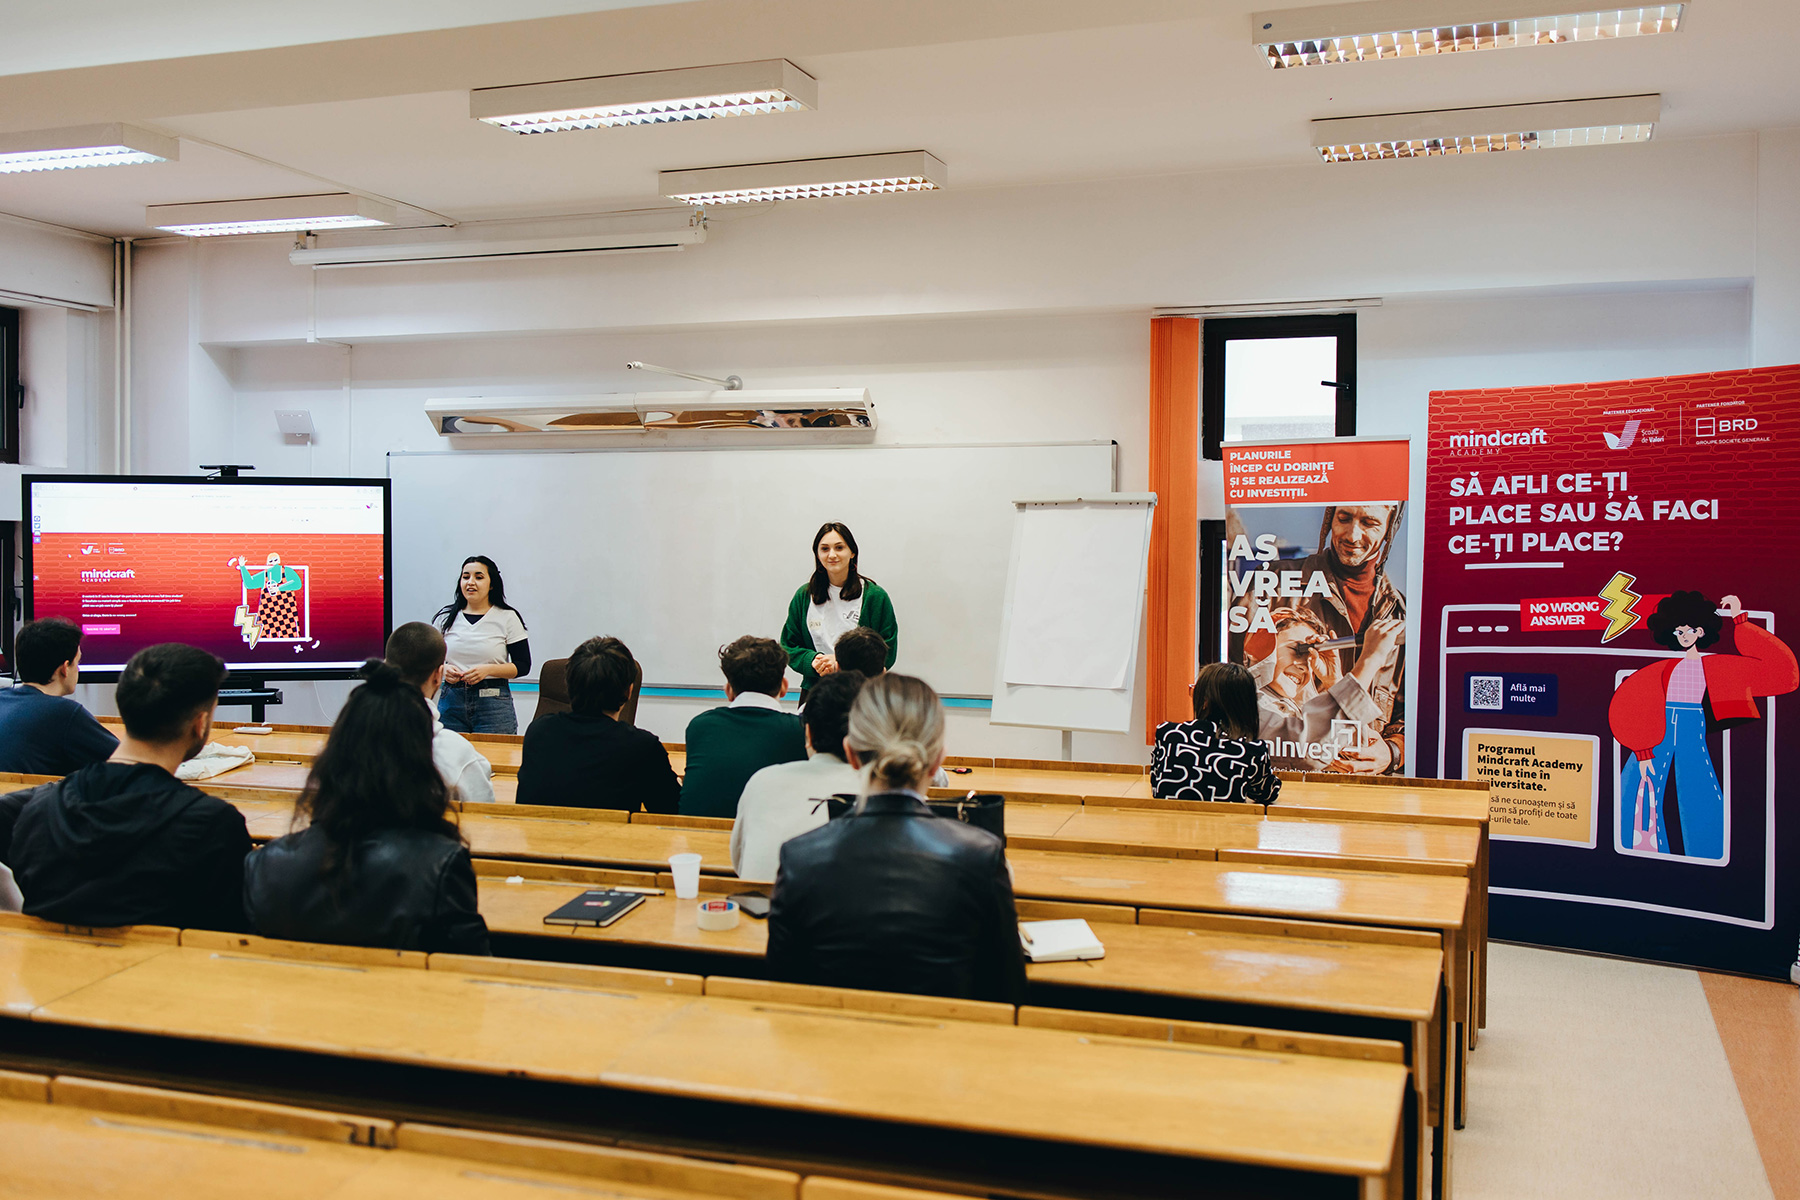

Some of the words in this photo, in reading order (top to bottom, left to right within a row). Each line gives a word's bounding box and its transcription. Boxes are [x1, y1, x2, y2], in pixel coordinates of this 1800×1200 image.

[1719, 418, 1758, 432] BRD
[1449, 427, 1547, 448] mindcraft
[1229, 450, 1291, 461] PLANURILE
[1449, 448, 1500, 456] ACADEMY
[1229, 462, 1262, 473] ÎNCEP
[1265, 463, 1281, 472] CU
[1283, 461, 1334, 473] DORINȚE
[1229, 477, 1239, 488] ȘI
[1242, 476, 1255, 485] SE
[1258, 472, 1329, 485] REALIZEAZĂ
[1450, 471, 1484, 497] SĂ
[1491, 474, 1548, 495] AFLI
[1556, 471, 1628, 499] CE-ȚI
[1229, 489, 1244, 498] CU
[1247, 488, 1308, 499] INVESTIȚII.
[1450, 503, 1531, 526] PLACE
[1539, 502, 1596, 523] SAU
[1604, 495, 1644, 522] SĂ
[1653, 499, 1719, 520] FACI
[1228, 533, 1280, 570] AȘ
[1448, 532, 1513, 560] CE-ȚI
[1522, 531, 1624, 552] PLACE?
[81, 569, 135, 578] mindcraft
[1228, 570, 1333, 598] VREA
[1529, 603, 1548, 613] NO
[1550, 601, 1599, 613] WRONG
[1228, 596, 1278, 634] SĂ
[1530, 614, 1585, 627] ANSWER
[1510, 683, 1527, 692] Află
[1529, 684, 1546, 693] mai
[1510, 694, 1536, 703] multe
[1477, 743, 1536, 756] Programul
[1477, 755, 1530, 767] Mindcraft
[1532, 759, 1583, 773] Academy
[1477, 766, 1500, 776] vine
[1503, 767, 1512, 777] la
[1515, 768, 1537, 779] tine
[1539, 769, 1550, 780] în
[1477, 778, 1547, 791] iversitate.
[1491, 795, 1499, 803] să
[1566, 801, 1576, 809] să
[1508, 807, 1517, 815] să
[1544, 809, 1555, 818] de
[1556, 811, 1578, 820] toate
[1513, 817, 1530, 826] tale.
